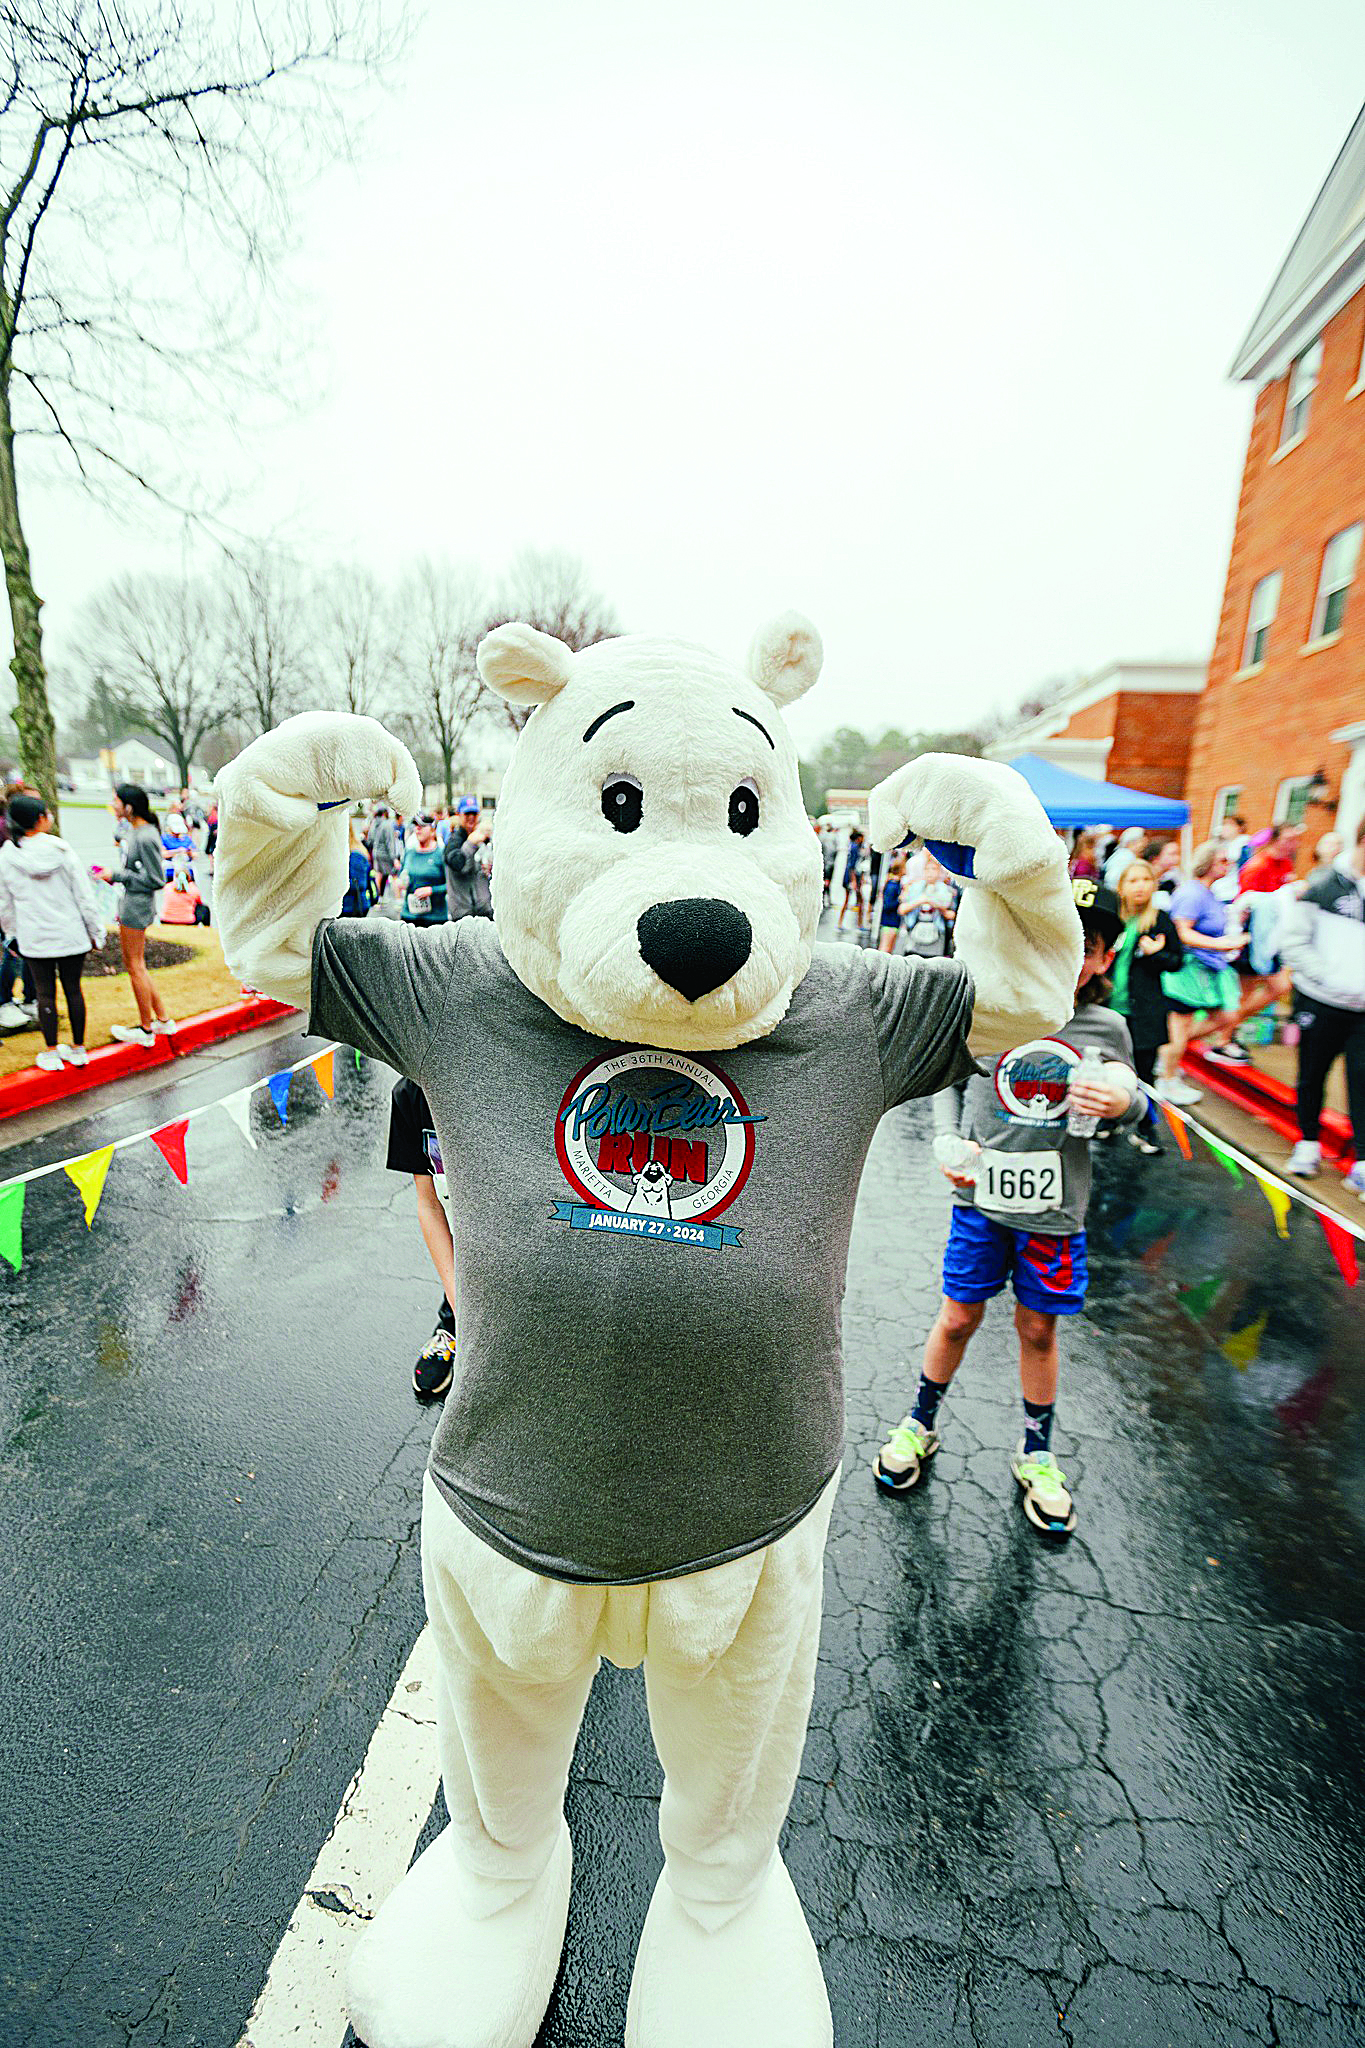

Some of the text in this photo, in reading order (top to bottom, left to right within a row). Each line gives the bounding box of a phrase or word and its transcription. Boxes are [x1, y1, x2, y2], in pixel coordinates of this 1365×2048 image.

[604, 1055, 714, 1087] THE 36TH ANNUAL
[561, 1078, 768, 1141] Polar Bear
[572, 1150, 612, 1199] MARIETTA
[597, 1130, 709, 1185] RUN
[692, 1169, 734, 1209] GEORGIA
[988, 1165, 1055, 1200] 1662
[589, 1213, 705, 1242] JANUARY 27 2024
